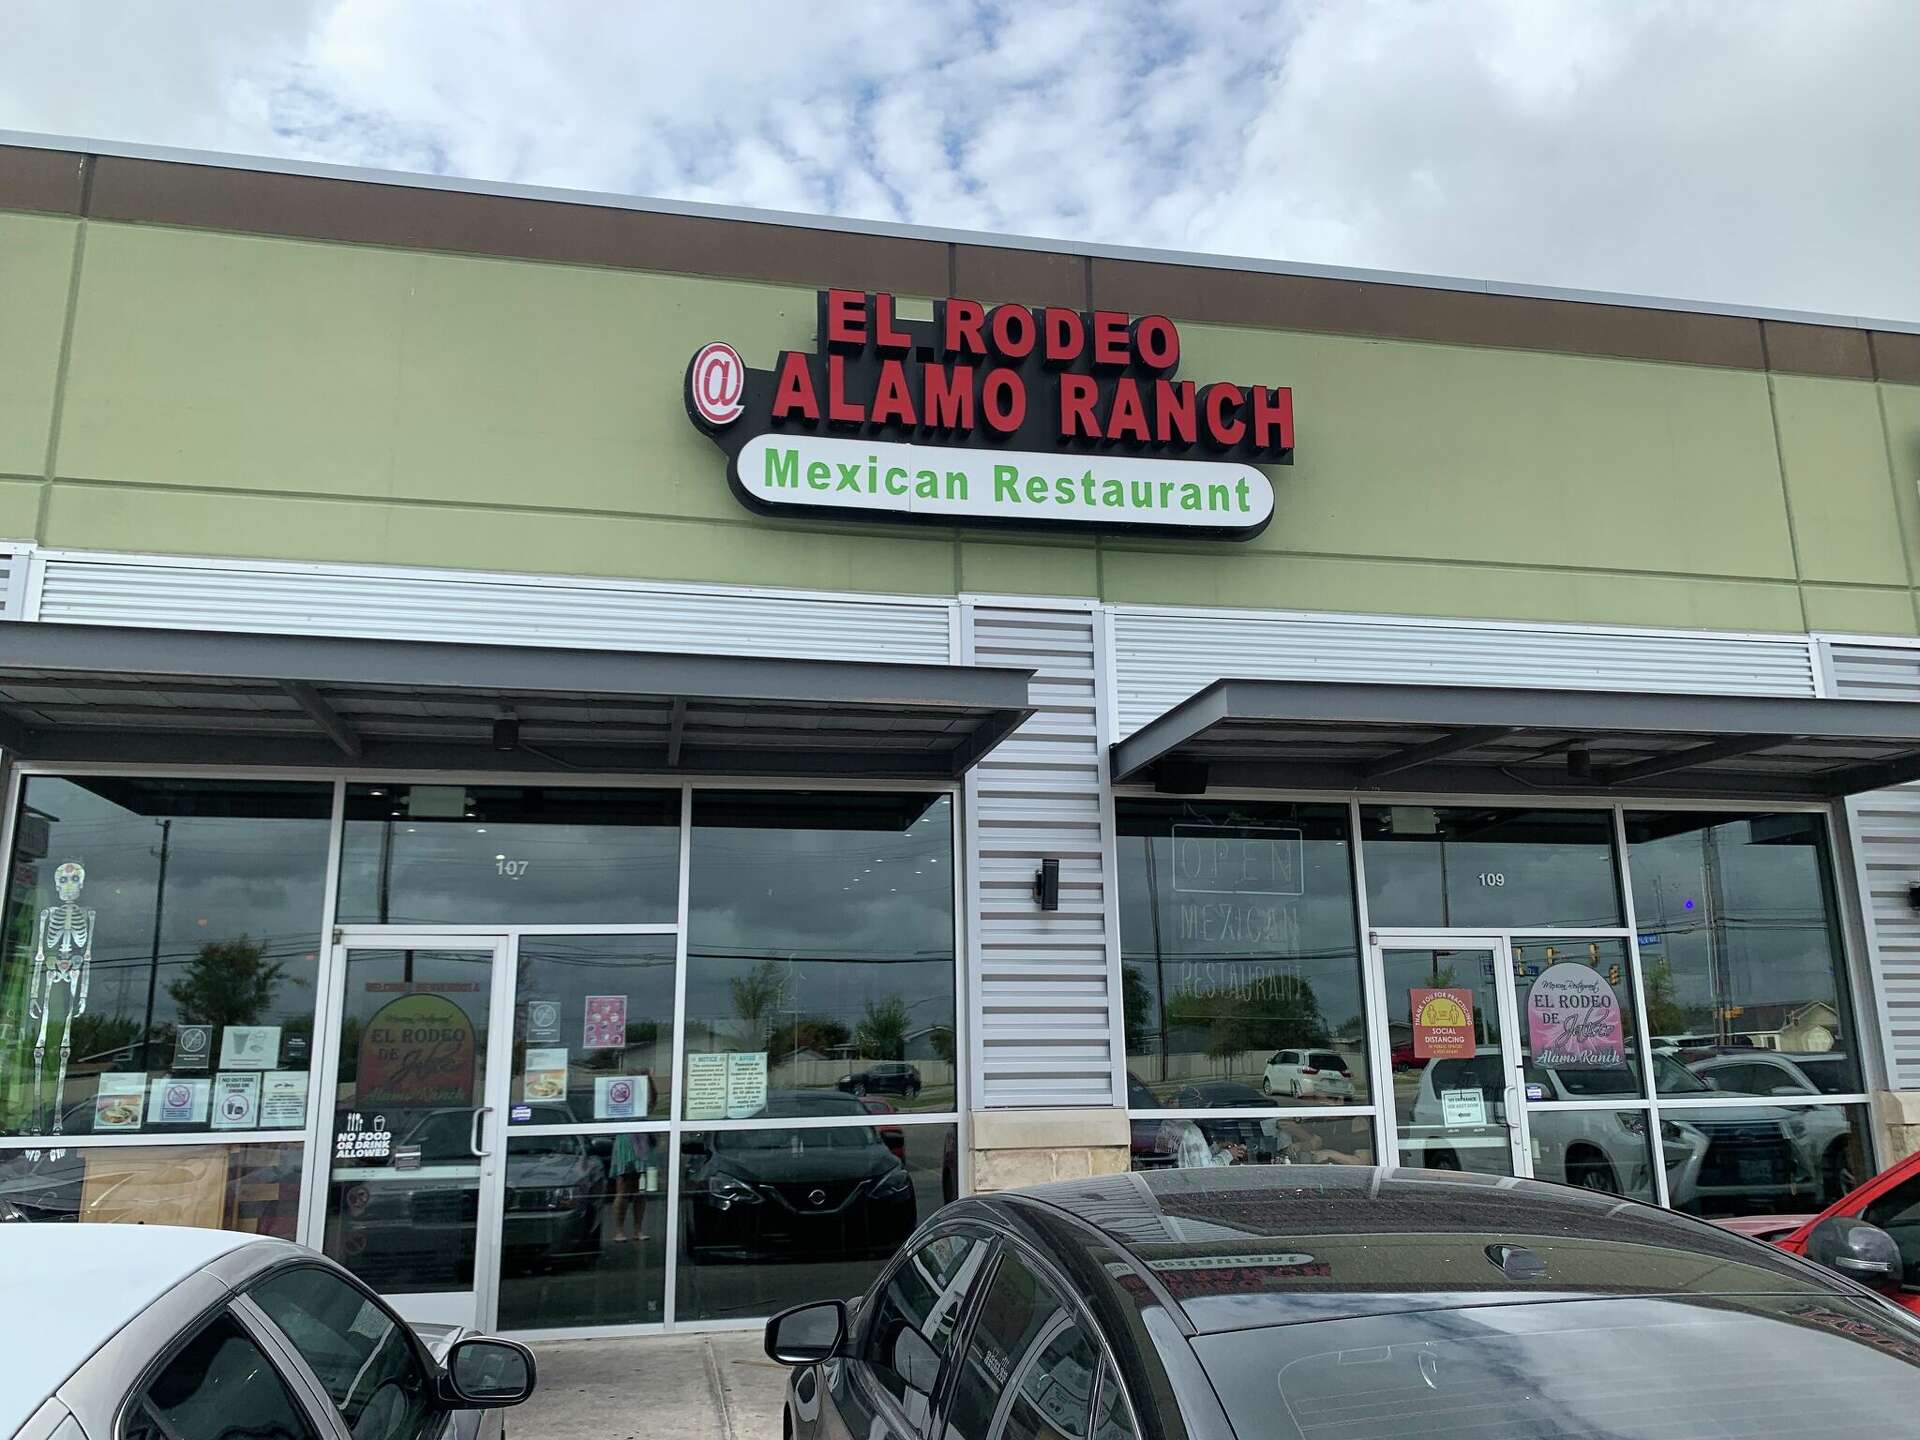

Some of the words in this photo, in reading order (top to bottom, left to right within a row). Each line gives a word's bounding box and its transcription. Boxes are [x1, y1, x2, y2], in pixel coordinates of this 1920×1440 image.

[828, 288, 912, 348] EL
[946, 297, 1180, 369] RODEO
[692, 341, 745, 424] @
[772, 352, 1027, 433] ALAMO
[1060, 372, 1295, 450] RANCH
[764, 447, 969, 501] Mexican
[993, 463, 1251, 513] Restaurant
[1181, 838, 1292, 882] OPEN
[495, 860, 529, 876] 107
[1478, 872, 1505, 887] 109
[1180, 903, 1298, 943] MEXICAN
[1179, 960, 1303, 1002] RESTAURANT
[1534, 994, 1554, 1008] EL
[1559, 994, 1612, 1009] RODEO
[1542, 1012, 1560, 1024] DE
[370, 1028, 393, 1043] EL
[402, 1028, 466, 1043] RODEO
[1432, 1027, 1456, 1035] SOCIAL
[1536, 1049, 1577, 1064] Alamo
[1581, 1049, 1624, 1065] Ranch
[337, 1132, 356, 1141] NO
[358, 1131, 392, 1141] FOOD
[336, 1141, 353, 1150] OR
[354, 1140, 390, 1149] DRINK
[335, 1148, 390, 1158] ALLOWED
